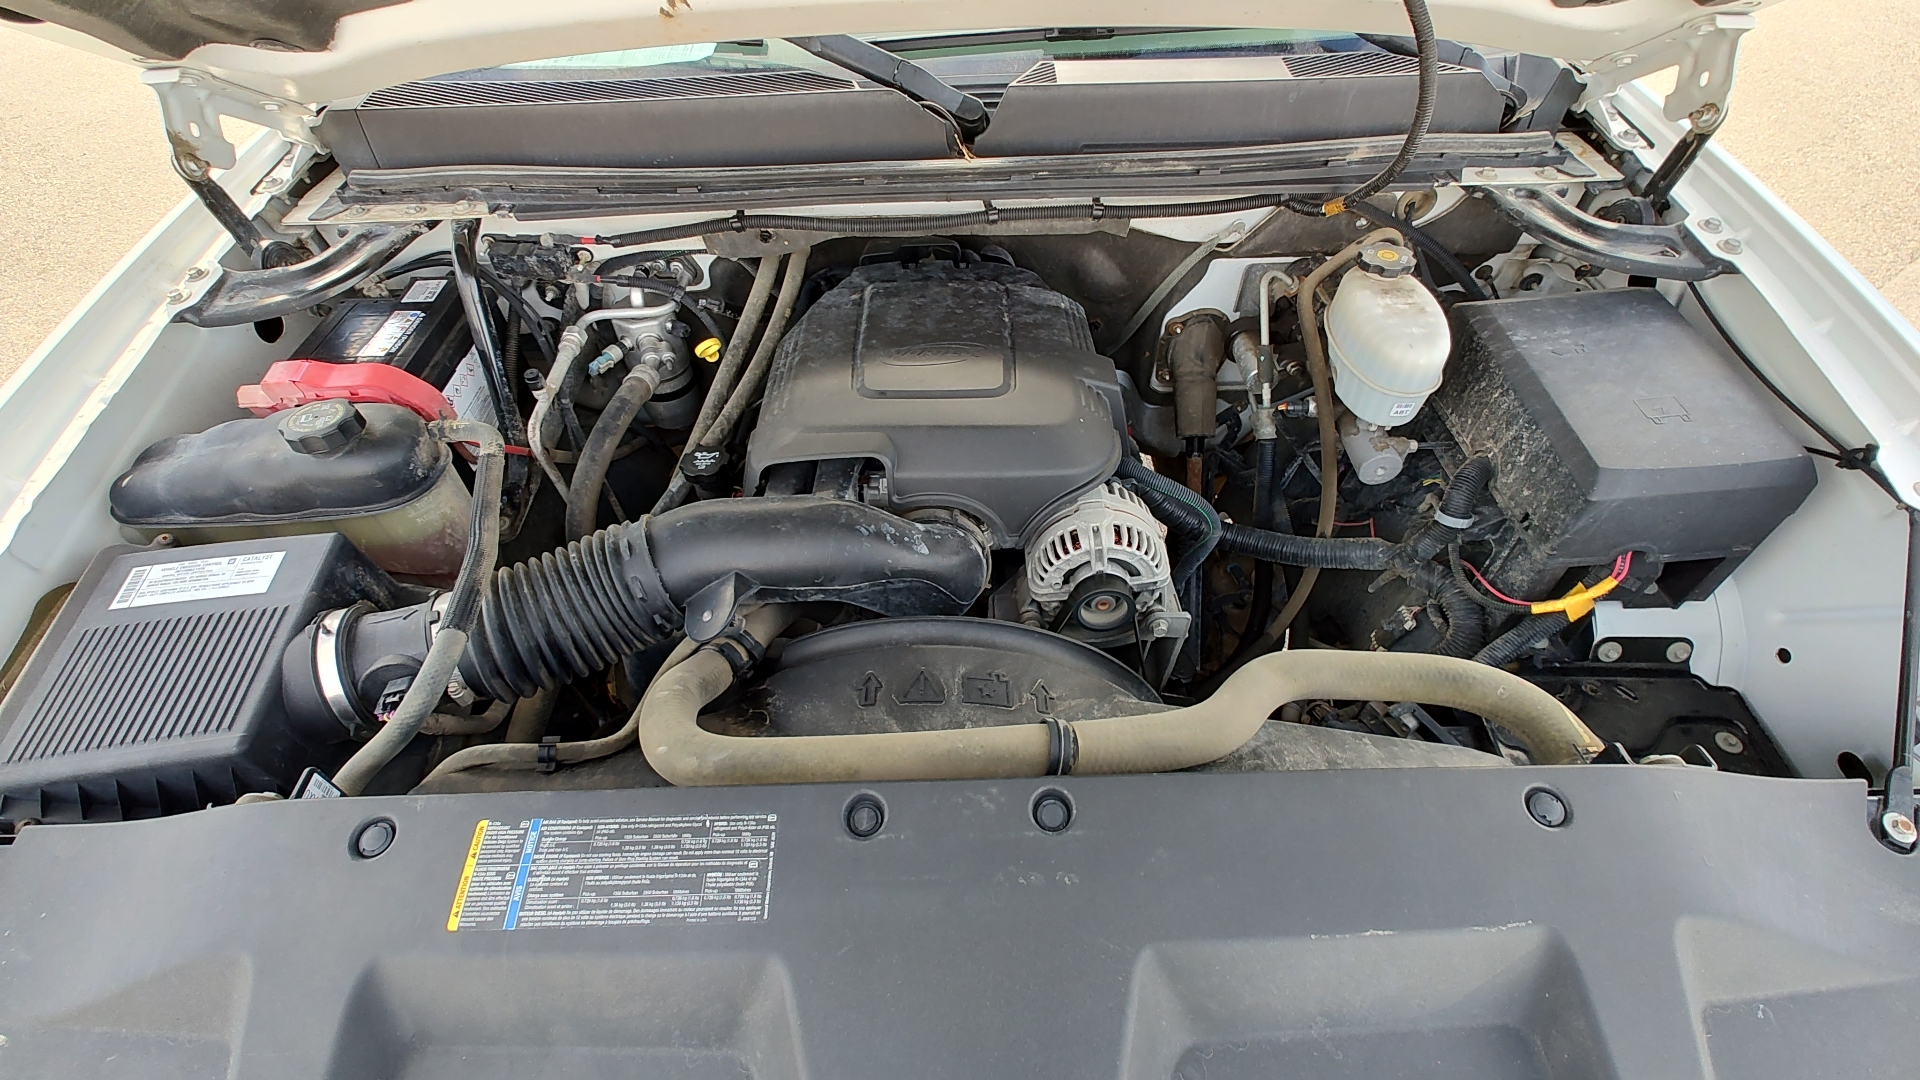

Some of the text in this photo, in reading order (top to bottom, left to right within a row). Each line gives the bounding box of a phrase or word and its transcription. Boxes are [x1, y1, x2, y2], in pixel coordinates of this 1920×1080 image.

[242, 554, 274, 562] CATALYST
[472, 825, 485, 851] CAUTION
[525, 830, 538, 854] NOTICE
[456, 875, 470, 910] ATTENTION
[513, 885, 523, 902] AVIS
